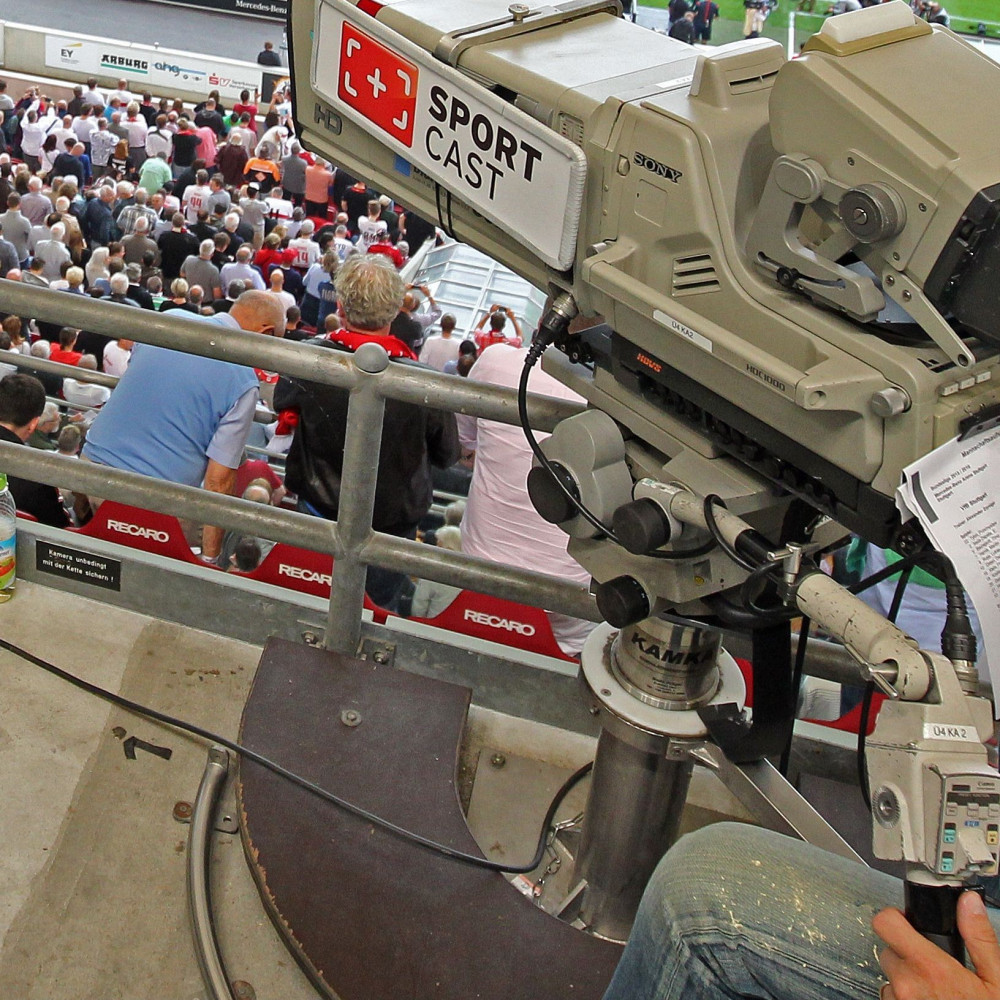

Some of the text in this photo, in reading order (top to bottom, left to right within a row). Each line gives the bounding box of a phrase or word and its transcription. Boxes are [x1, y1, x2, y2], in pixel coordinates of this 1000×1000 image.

[61, 48, 74, 58] EY
[102, 53, 149, 70] ARBURG
[313, 102, 343, 136] HD
[429, 85, 543, 182] SPORT
[425, 126, 504, 201] CAST
[633, 151, 683, 183] SONY
[107, 518, 170, 544] RECARO
[42, 558, 54, 568] mit
[54, 561, 66, 570] der
[66, 563, 83, 576] Kette
[85, 569, 109, 582] sichern
[48, 548, 107, 571] Kamera unbedingt
[279, 563, 332, 586] RECAR
[464, 608, 536, 638] RECARO
[947, 727, 960, 738] KA
[961, 728, 968, 739] 2
